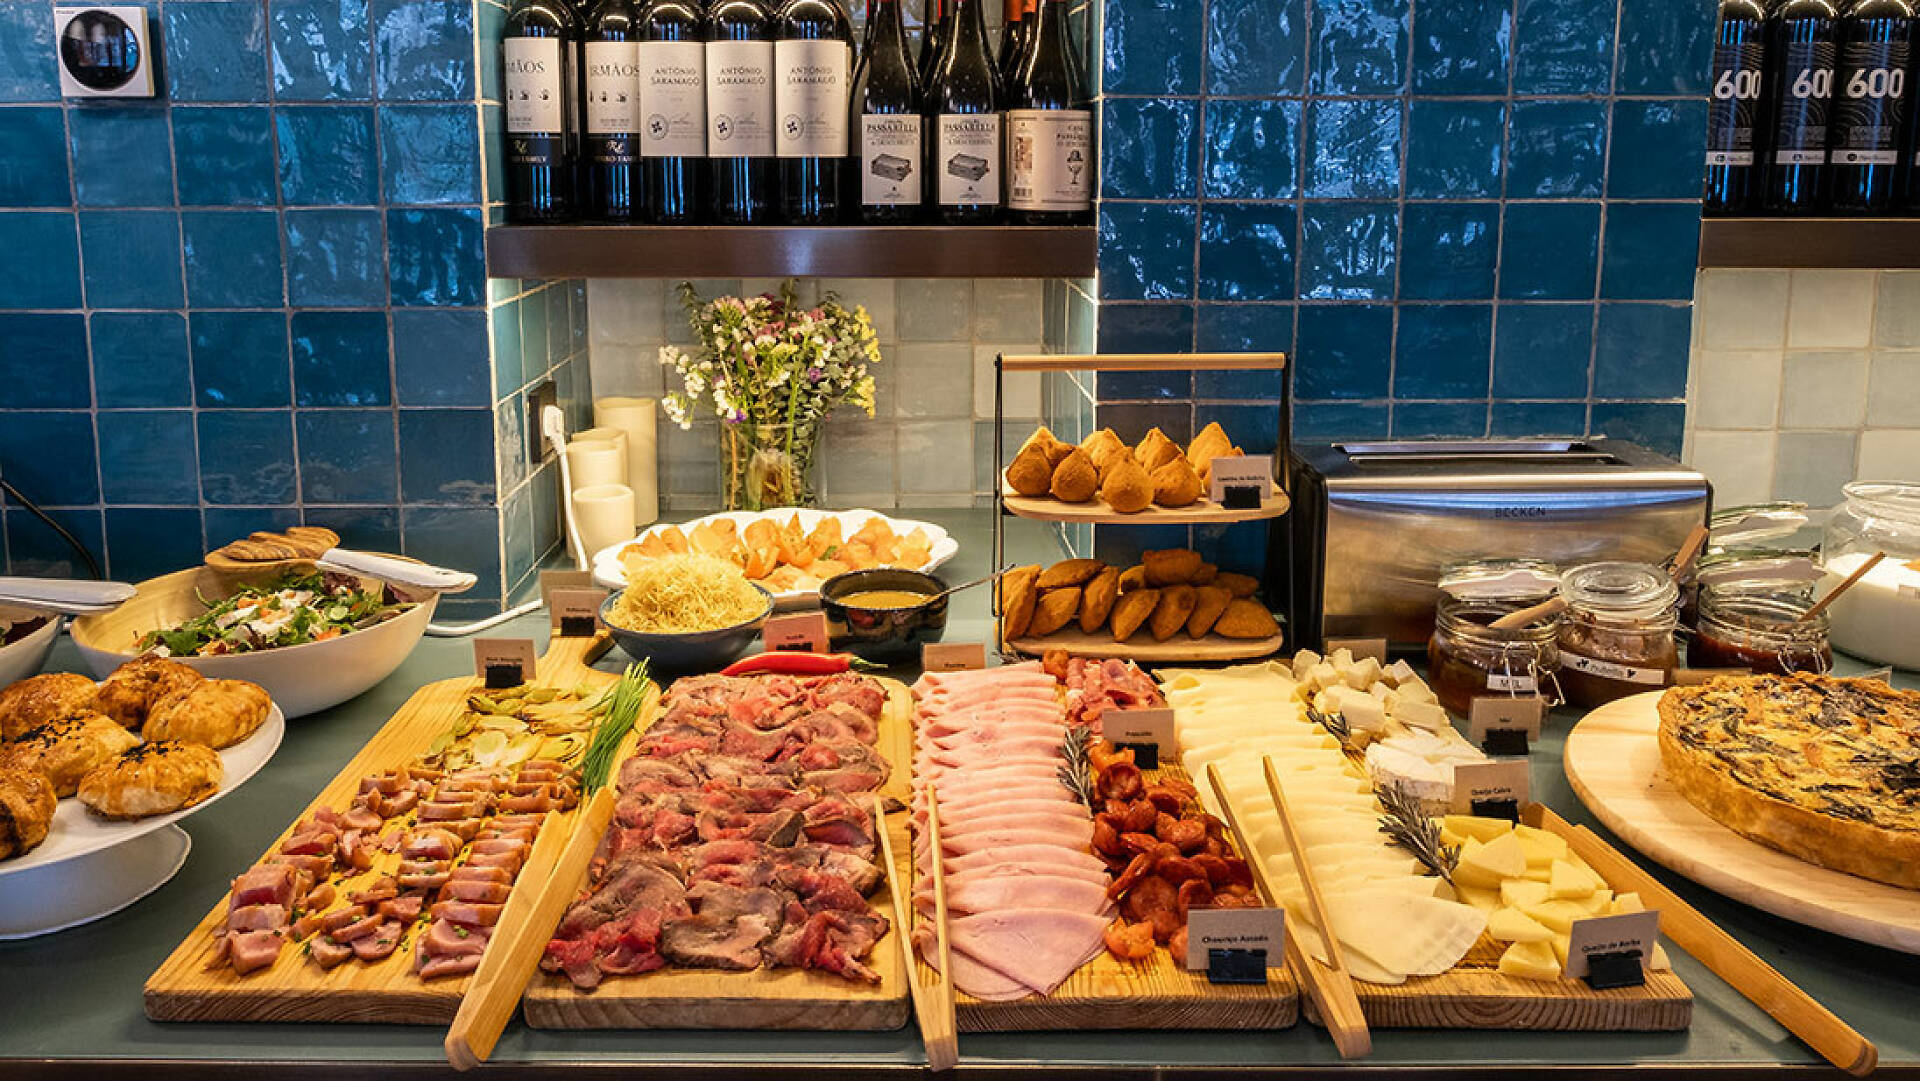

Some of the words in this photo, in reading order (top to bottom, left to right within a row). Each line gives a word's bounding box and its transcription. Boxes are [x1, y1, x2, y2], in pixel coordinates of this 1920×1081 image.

[655, 65, 697, 76] ANTÓNIO
[720, 65, 763, 76] ANTÓNIO
[789, 65, 832, 76] ANTÓNIO
[650, 76, 700, 86] SARAMAGO
[716, 76, 766, 86] SARAMAGO
[787, 76, 837, 86] SARAMAGO
[1714, 69, 1762, 99] 600
[1846, 67, 1905, 99] 600
[1495, 507, 1546, 518] BECKEN
[1471, 788, 1492, 797] Queijo
[1582, 943, 1607, 953] Queijo
